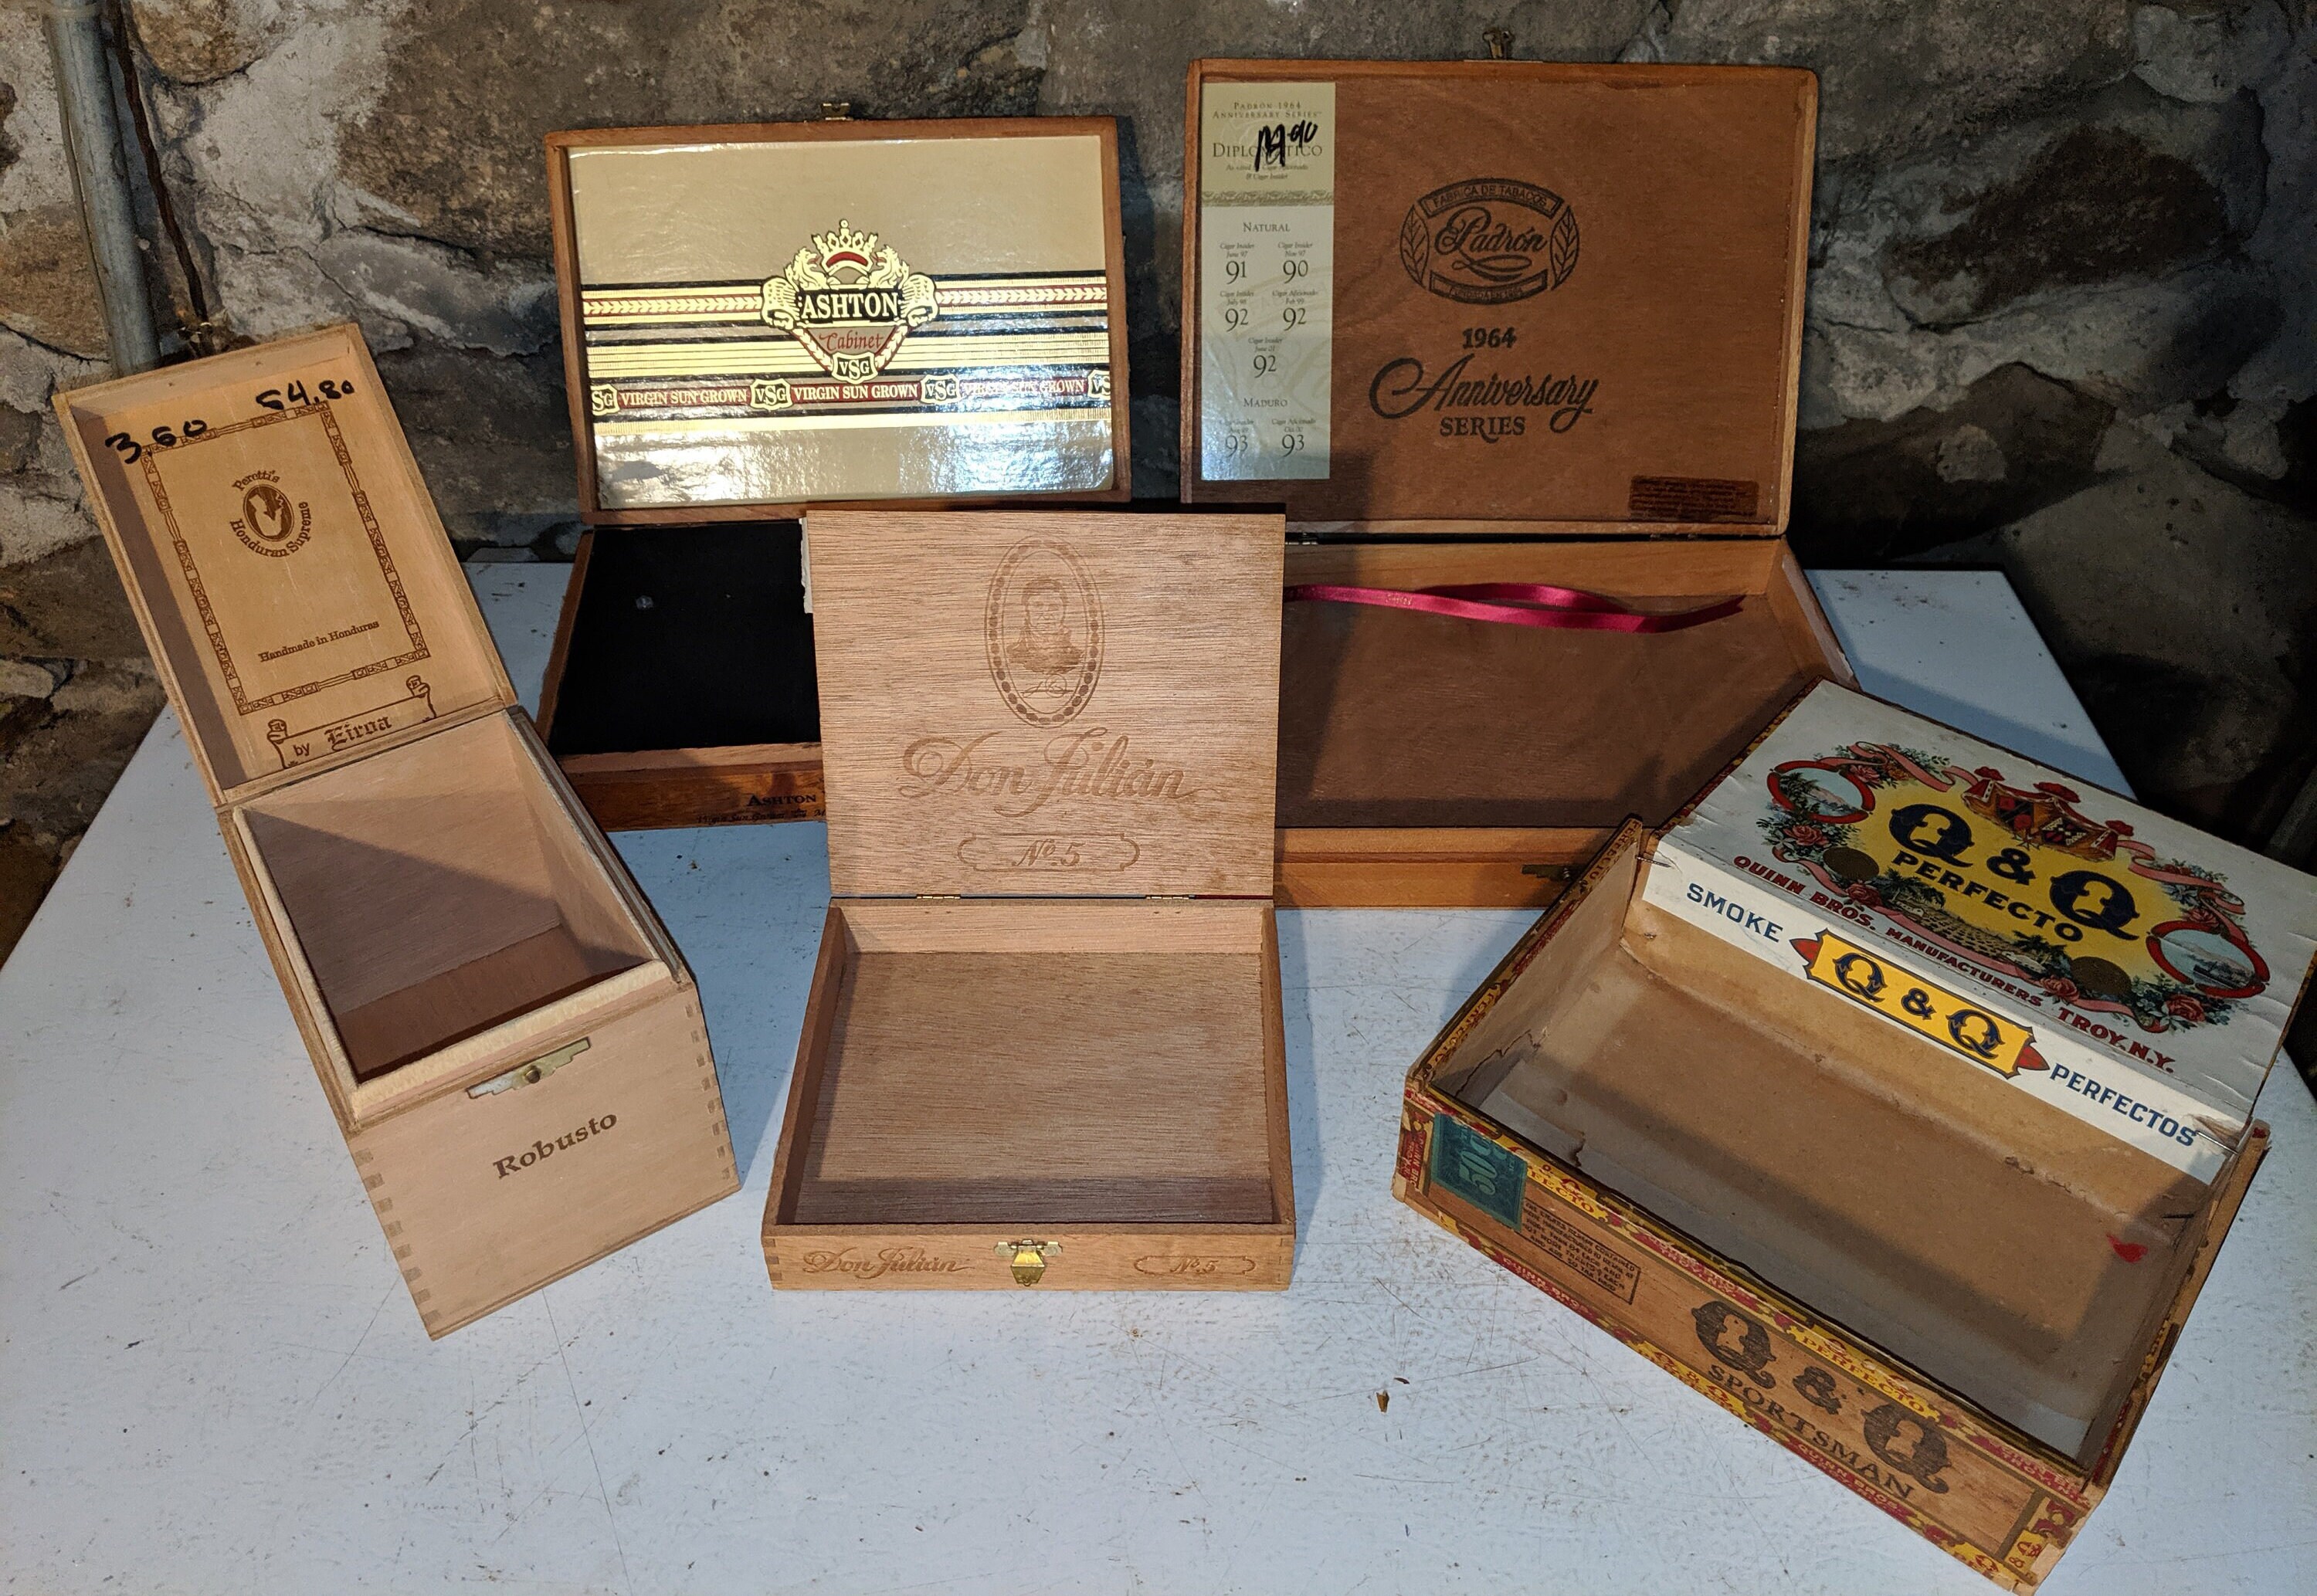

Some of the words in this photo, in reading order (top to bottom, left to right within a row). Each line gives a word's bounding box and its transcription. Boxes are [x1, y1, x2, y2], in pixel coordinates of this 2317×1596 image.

[1243, 222, 1291, 232] NATURAL
[1226, 259, 1247, 285] 91
[1283, 259, 1308, 284] 90
[802, 292, 899, 319] ASHTON
[1283, 307, 1307, 331] 92
[1225, 308, 1249, 333] 92
[819, 330, 885, 351] Cabinet
[1462, 327, 1517, 349] 1964
[839, 359, 870, 380] VSG
[1253, 354, 1277, 378] 92
[620, 391, 668, 407] VIRGIN
[670, 390, 697, 405] SUN
[701, 388, 748, 404] GROWN
[755, 385, 788, 405] VSG
[792, 386, 840, 401] VIRGIN
[843, 385, 870, 400] SUN
[871, 384, 918, 398] GROWN
[927, 380, 957, 401] VSG
[1040, 378, 1085, 394] GROWN
[1243, 398, 1288, 408] MADURO
[1369, 354, 1600, 434] Anniversary
[1440, 416, 1525, 444] SERIES
[1225, 435, 1248, 458] 93
[1281, 434, 1305, 457] 93
[229, 518, 290, 557] Honduran
[286, 501, 311, 554] Supreme
[258, 639, 315, 662] Handmade
[317, 636, 329, 646] in
[327, 621, 380, 642] Honduras
[293, 742, 310, 757] by
[897, 732, 1031, 798] Don
[747, 794, 816, 807] ASHTON
[1060, 841, 1087, 866] 5
[1889, 803, 1975, 868] Q
[1986, 848, 2036, 886] &
[2050, 870, 2140, 940] Q
[1891, 850, 2084, 942] PERFECTO
[1687, 883, 1783, 943] SMOKE
[1733, 856, 1806, 895] QUINN
[1810, 891, 1877, 931] BROS.
[1885, 927, 2043, 1007] MANUFACTURERS
[1832, 952, 1888, 1003] Q
[1901, 988, 1937, 1020] &
[1945, 1008, 2007, 1060] Q
[2049, 1062, 2199, 1147] PERFECTOS
[493, 1113, 618, 1180] Robusto
[1528, 1170, 1596, 1214] FECTO
[802, 1246, 875, 1273] Don
[1202, 1259, 1219, 1274] 5
[1801, 1336, 1926, 1413] PERFECTO
[1691, 1300, 1777, 1390] Q
[1792, 1364, 1844, 1415] &
[1860, 1403, 1952, 1495] Q
[1707, 1363, 1913, 1499] SPORTSMAN
